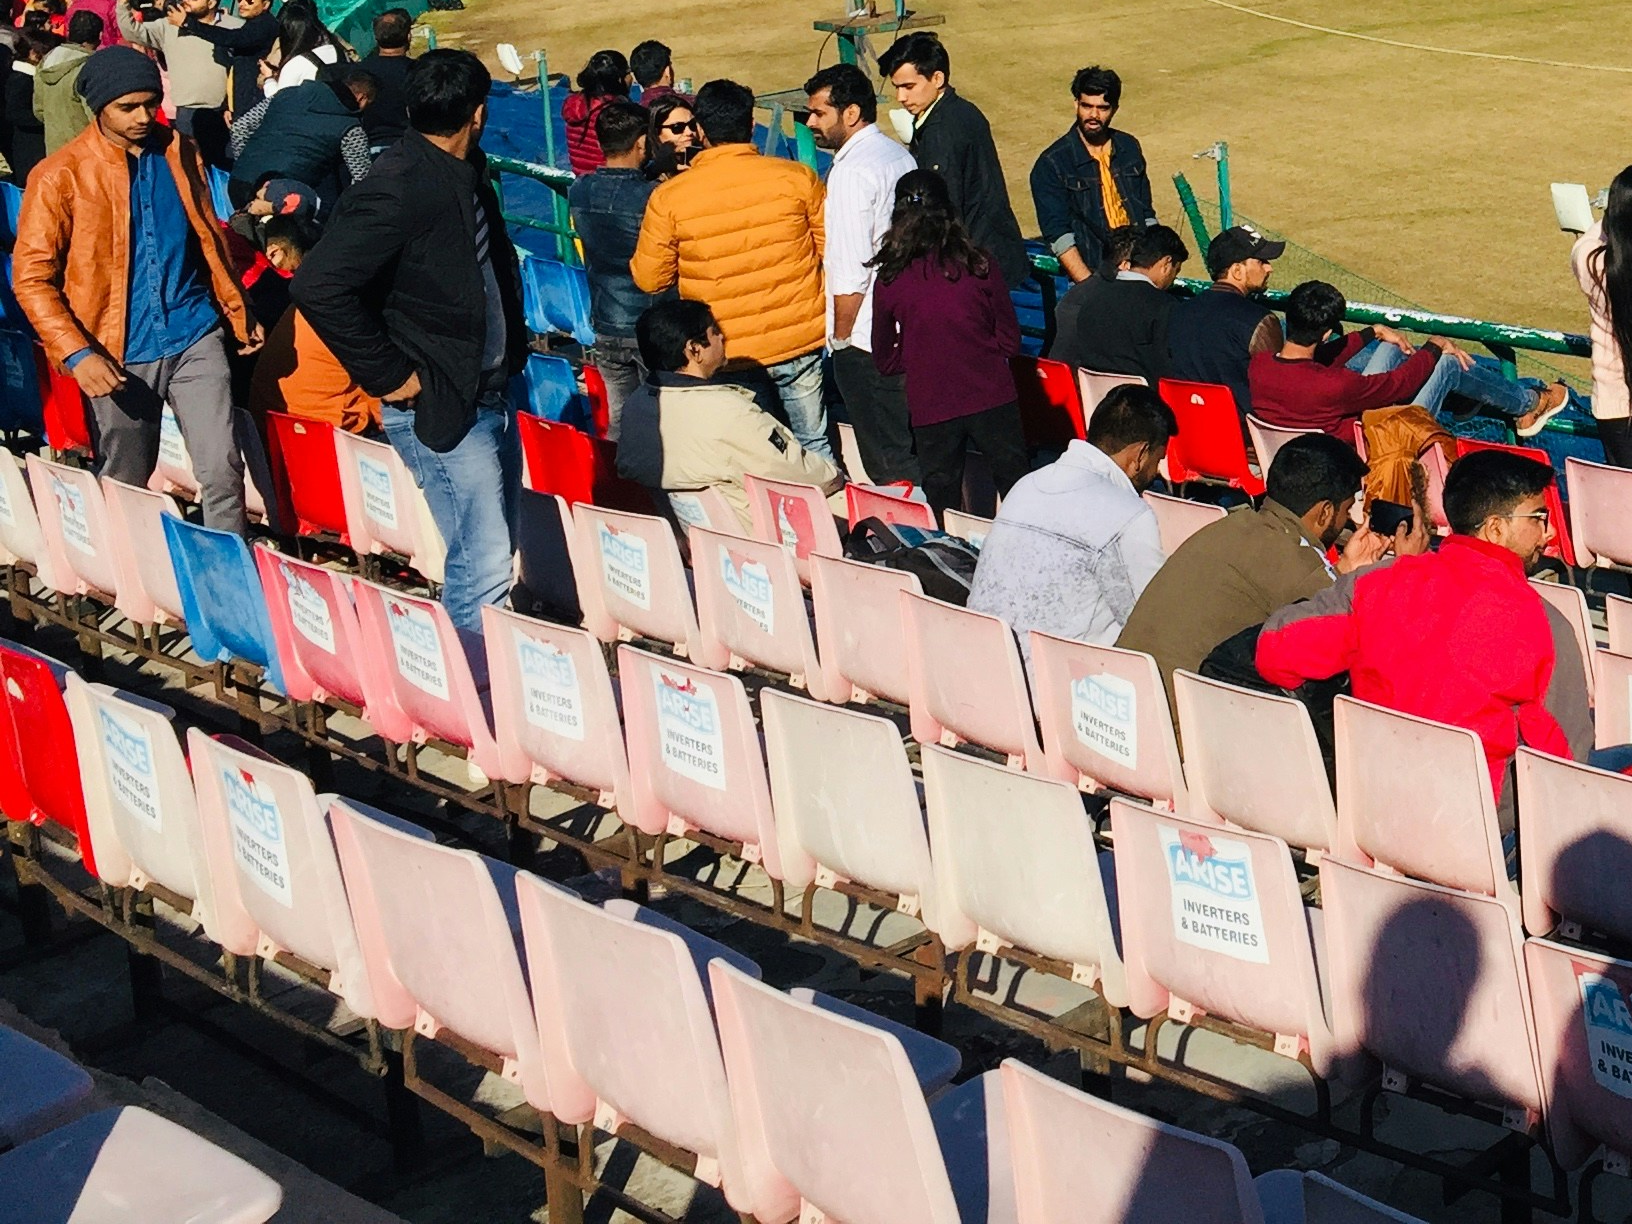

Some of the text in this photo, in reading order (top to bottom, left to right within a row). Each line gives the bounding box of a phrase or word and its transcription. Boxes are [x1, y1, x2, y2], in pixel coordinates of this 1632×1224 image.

[602, 533, 644, 571] ARISE
[400, 644, 437, 673] INVERTERS
[405, 660, 443, 688] BATTERIES
[530, 687, 573, 710] INVERTERS
[536, 703, 578, 727] BATTERIES
[661, 688, 713, 731] ARISE
[1077, 679, 1129, 722] ARISE
[666, 727, 713, 756] INVERTERS
[1077, 722, 1130, 757] & BATTERIES
[1080, 711, 1126, 741] INVERTERS
[101, 713, 150, 774] ARISE
[665, 743, 719, 774] & BATTERIES
[112, 758, 150, 799] INVERTERS
[117, 778, 156, 819] BATTERIES
[226, 774, 278, 840] ARISE
[235, 824, 279, 867] INVERTERS
[241, 845, 285, 889] BATTERIES
[1183, 898, 1250, 926] INVERTERS
[1181, 916, 1258, 947] & BATTERIES
[1597, 1059, 1608, 1074] &
